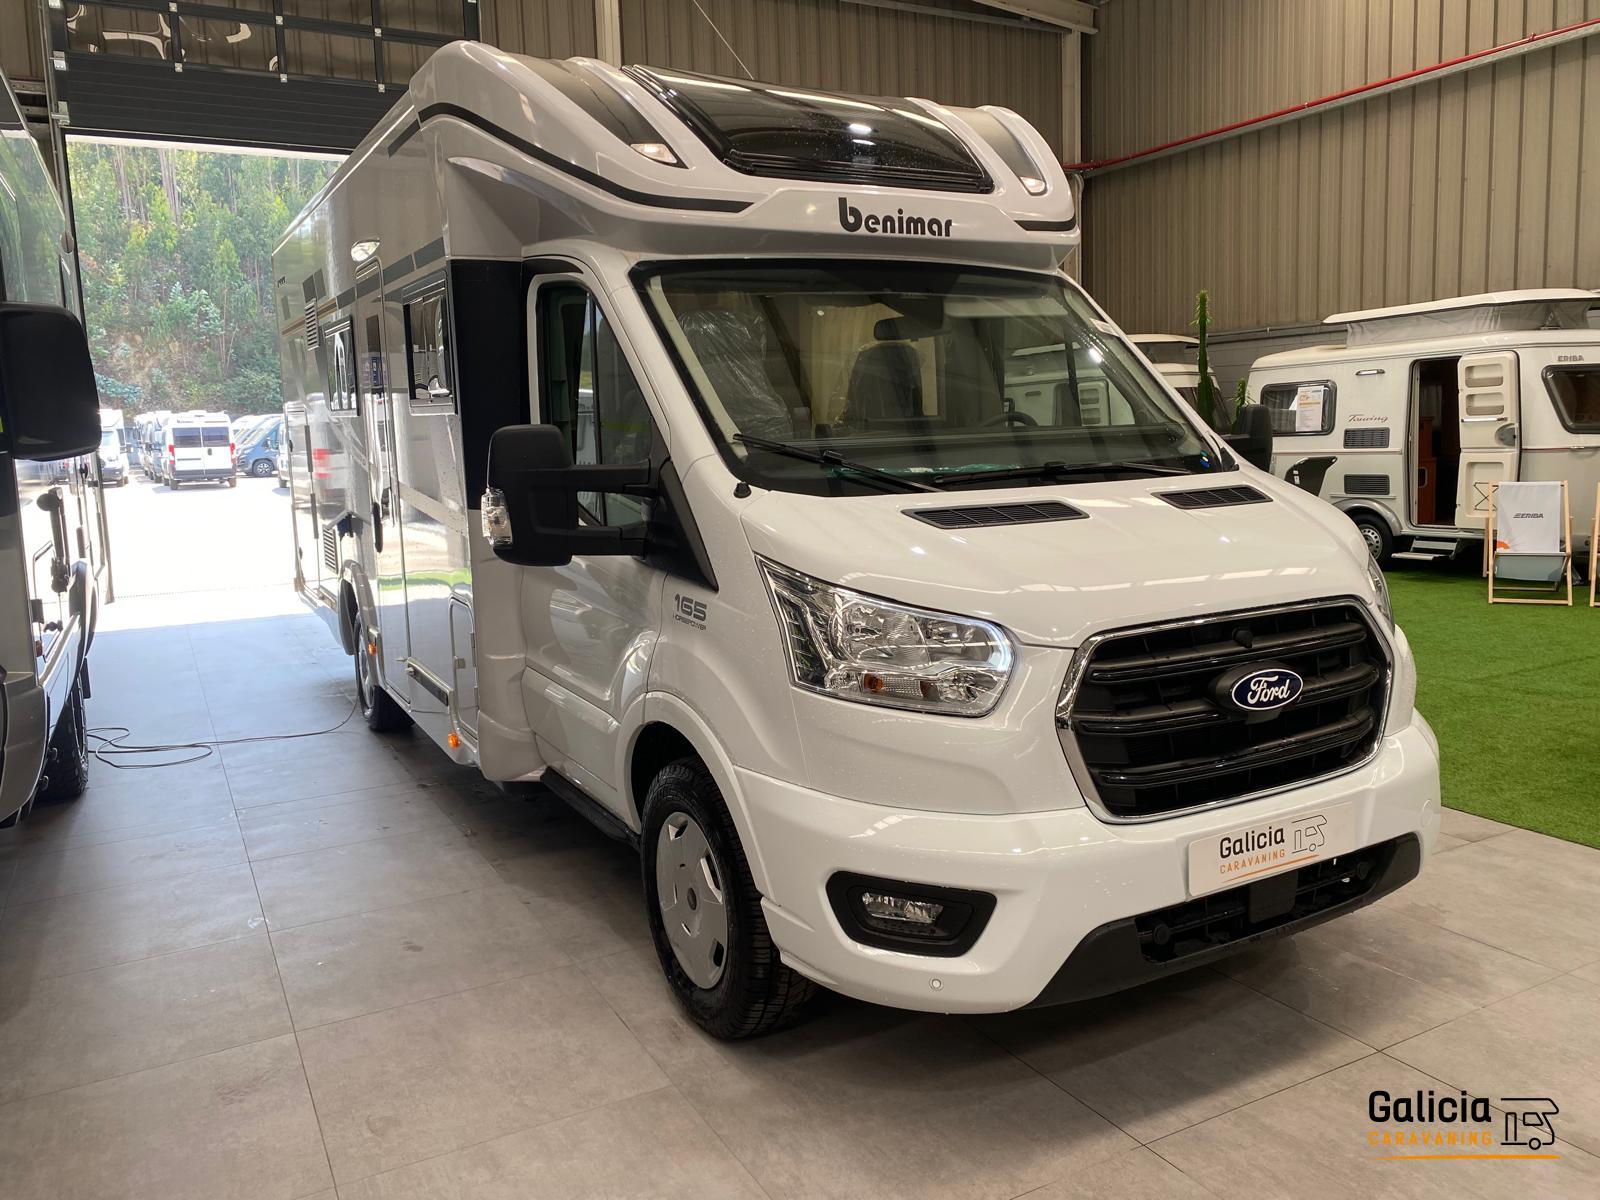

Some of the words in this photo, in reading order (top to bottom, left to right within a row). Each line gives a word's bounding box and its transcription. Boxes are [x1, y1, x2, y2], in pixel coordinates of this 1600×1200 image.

[838, 197, 953, 237] benimar
[1557, 354, 1585, 362] ERIBA
[1348, 413, 1389, 423] Touring
[674, 593, 707, 622] 165
[1247, 675, 1291, 704] Ford
[1219, 826, 1285, 859] Galicia
[1219, 848, 1286, 875] CARAVANING
